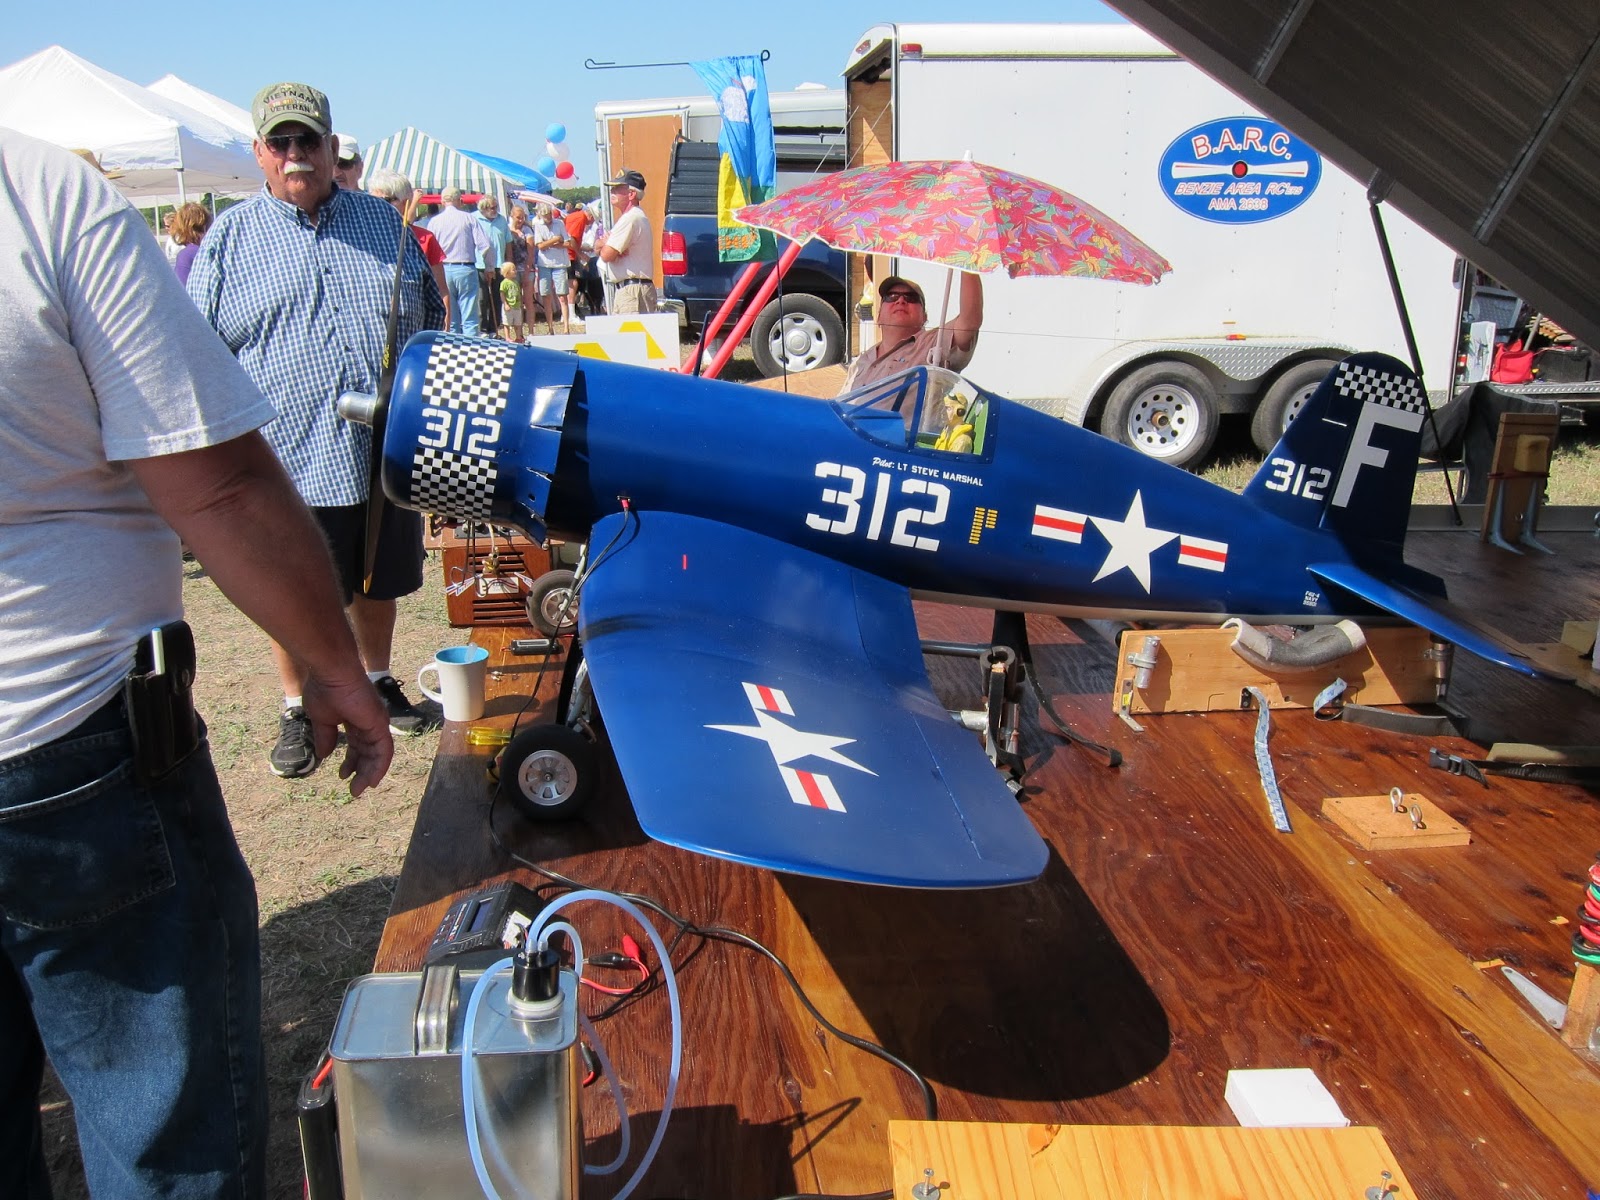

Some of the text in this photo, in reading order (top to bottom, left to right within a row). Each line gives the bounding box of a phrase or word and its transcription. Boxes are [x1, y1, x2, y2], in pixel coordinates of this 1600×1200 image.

[263, 91, 314, 104] VIETNAM
[270, 104, 311, 113] VETERAN
[1192, 127, 1293, 160] B.A.R.C.
[1175, 182, 1224, 195] BENZIE
[1224, 182, 1261, 195] AREA
[1208, 198, 1269, 211] AMA 2638
[418, 407, 501, 458] 312
[1331, 401, 1425, 508] F
[872, 457, 984, 487] Pilot: LT STEVE MARSHAL
[1265, 457, 1332, 501] 312
[805, 461, 951, 552] 312
